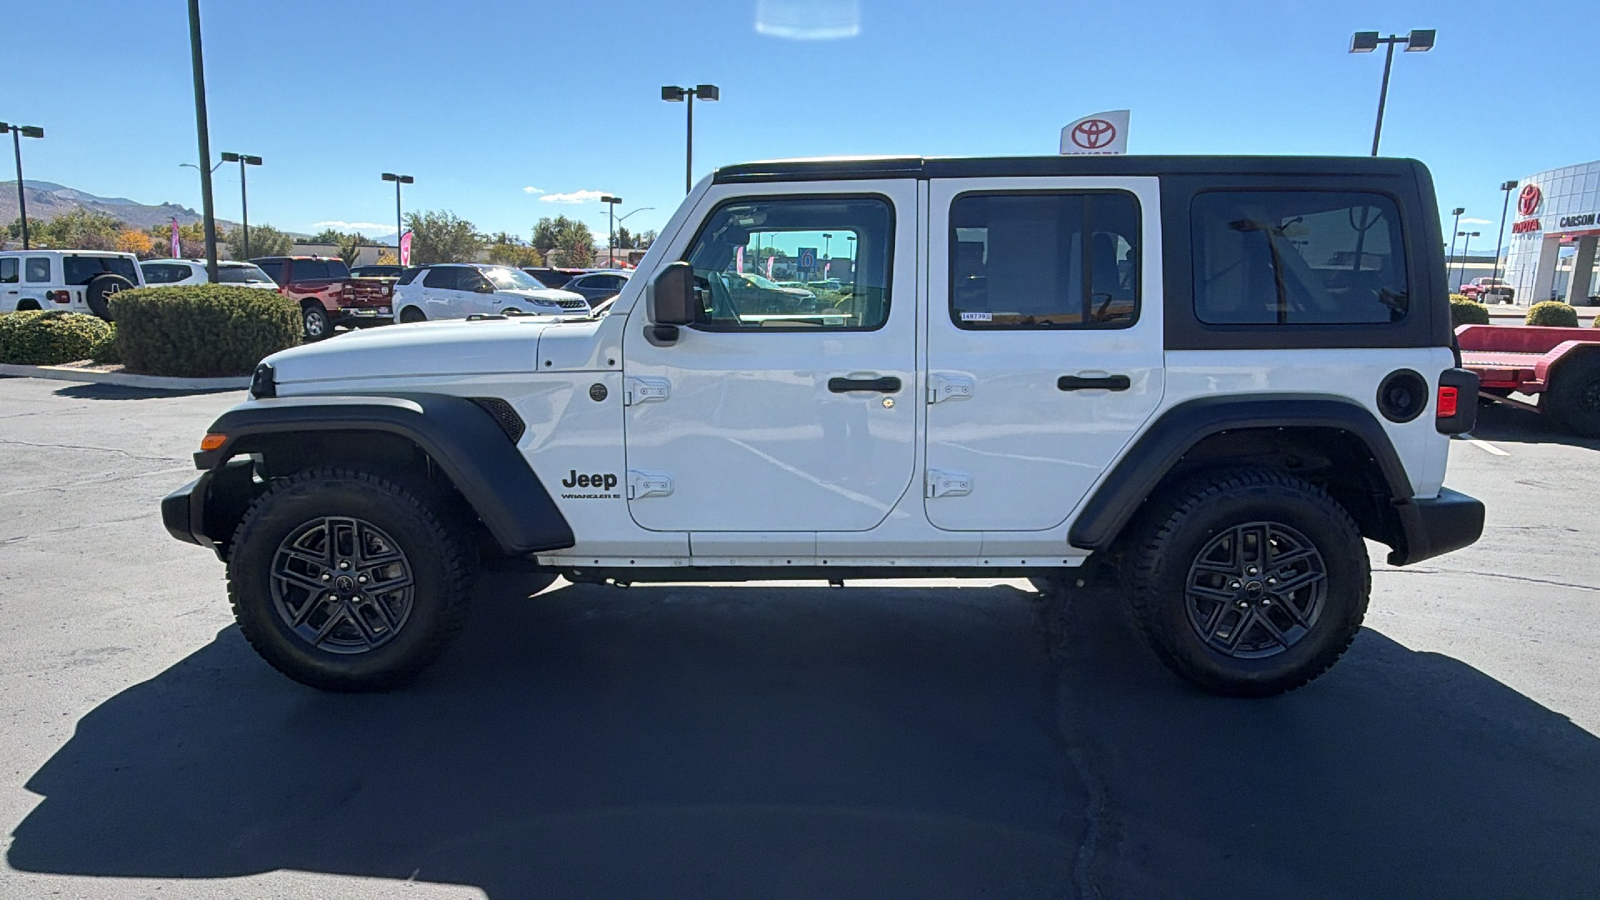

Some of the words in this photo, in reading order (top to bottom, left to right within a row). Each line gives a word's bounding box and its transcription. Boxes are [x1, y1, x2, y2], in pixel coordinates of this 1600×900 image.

[1512, 219, 1539, 233] TOYOTA
[1560, 213, 1595, 228] CARSON
[802, 249, 814, 268] 6
[562, 469, 618, 491] Jeep
